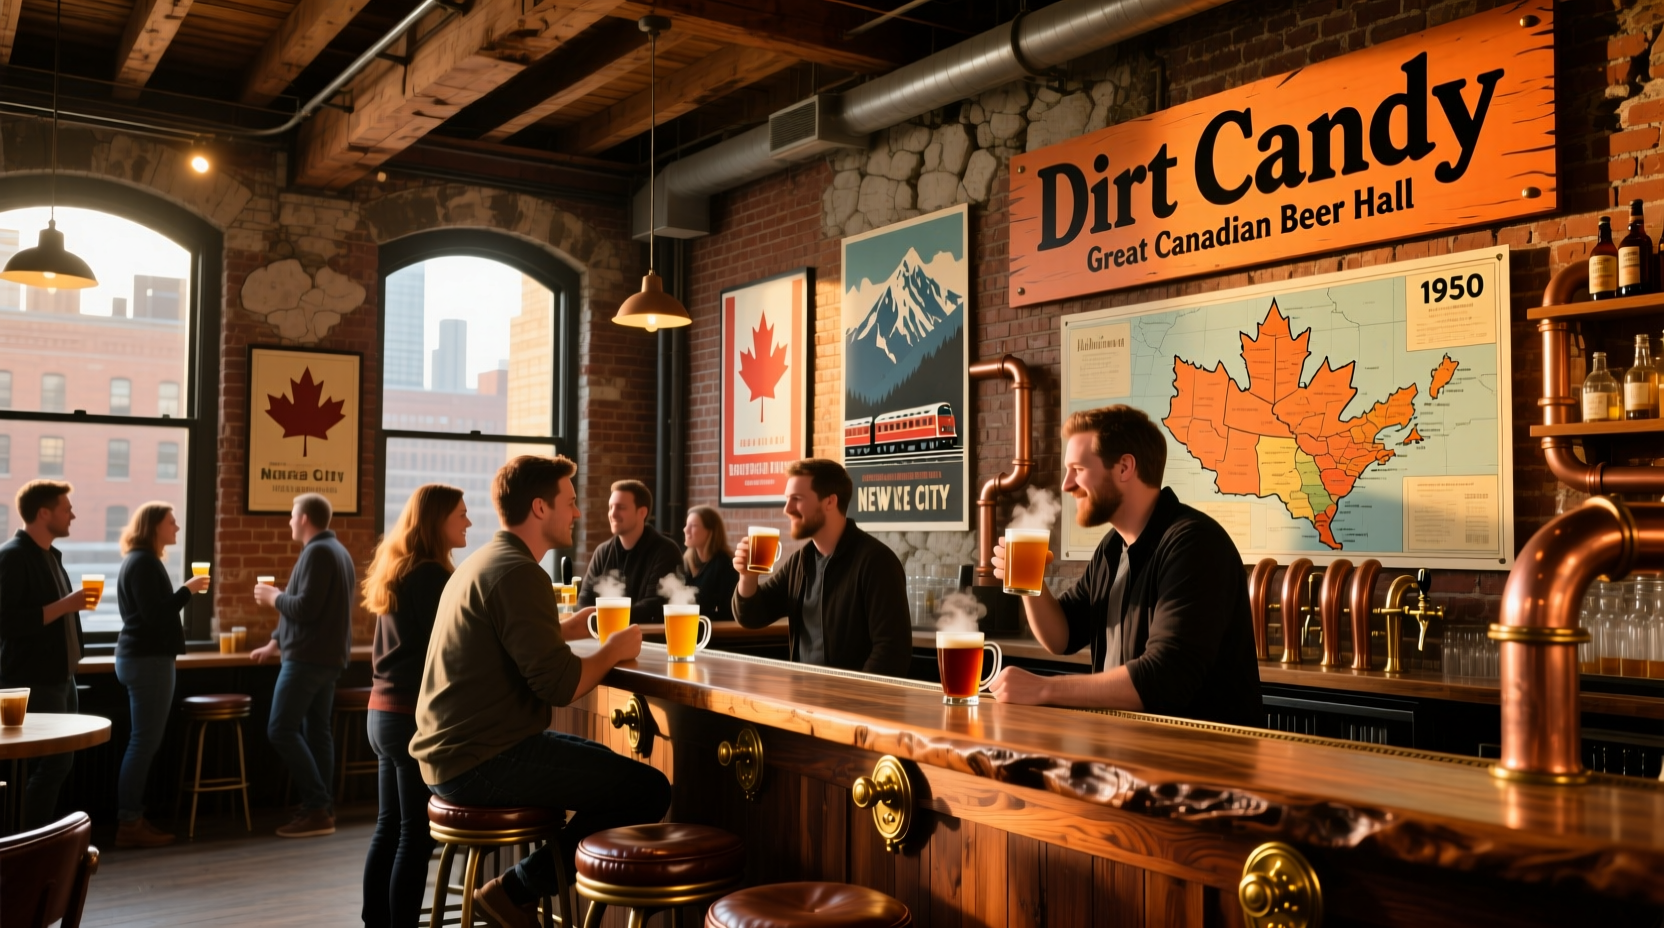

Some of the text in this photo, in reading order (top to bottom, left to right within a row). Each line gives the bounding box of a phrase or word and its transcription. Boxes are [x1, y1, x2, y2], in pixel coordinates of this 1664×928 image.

[1037, 52, 1504, 252] Dirt Candy
[1087, 179, 1415, 272] Great Canadian Beer Hall
[1420, 273, 1484, 304] 1950
[915, 484, 950, 511] CITY
